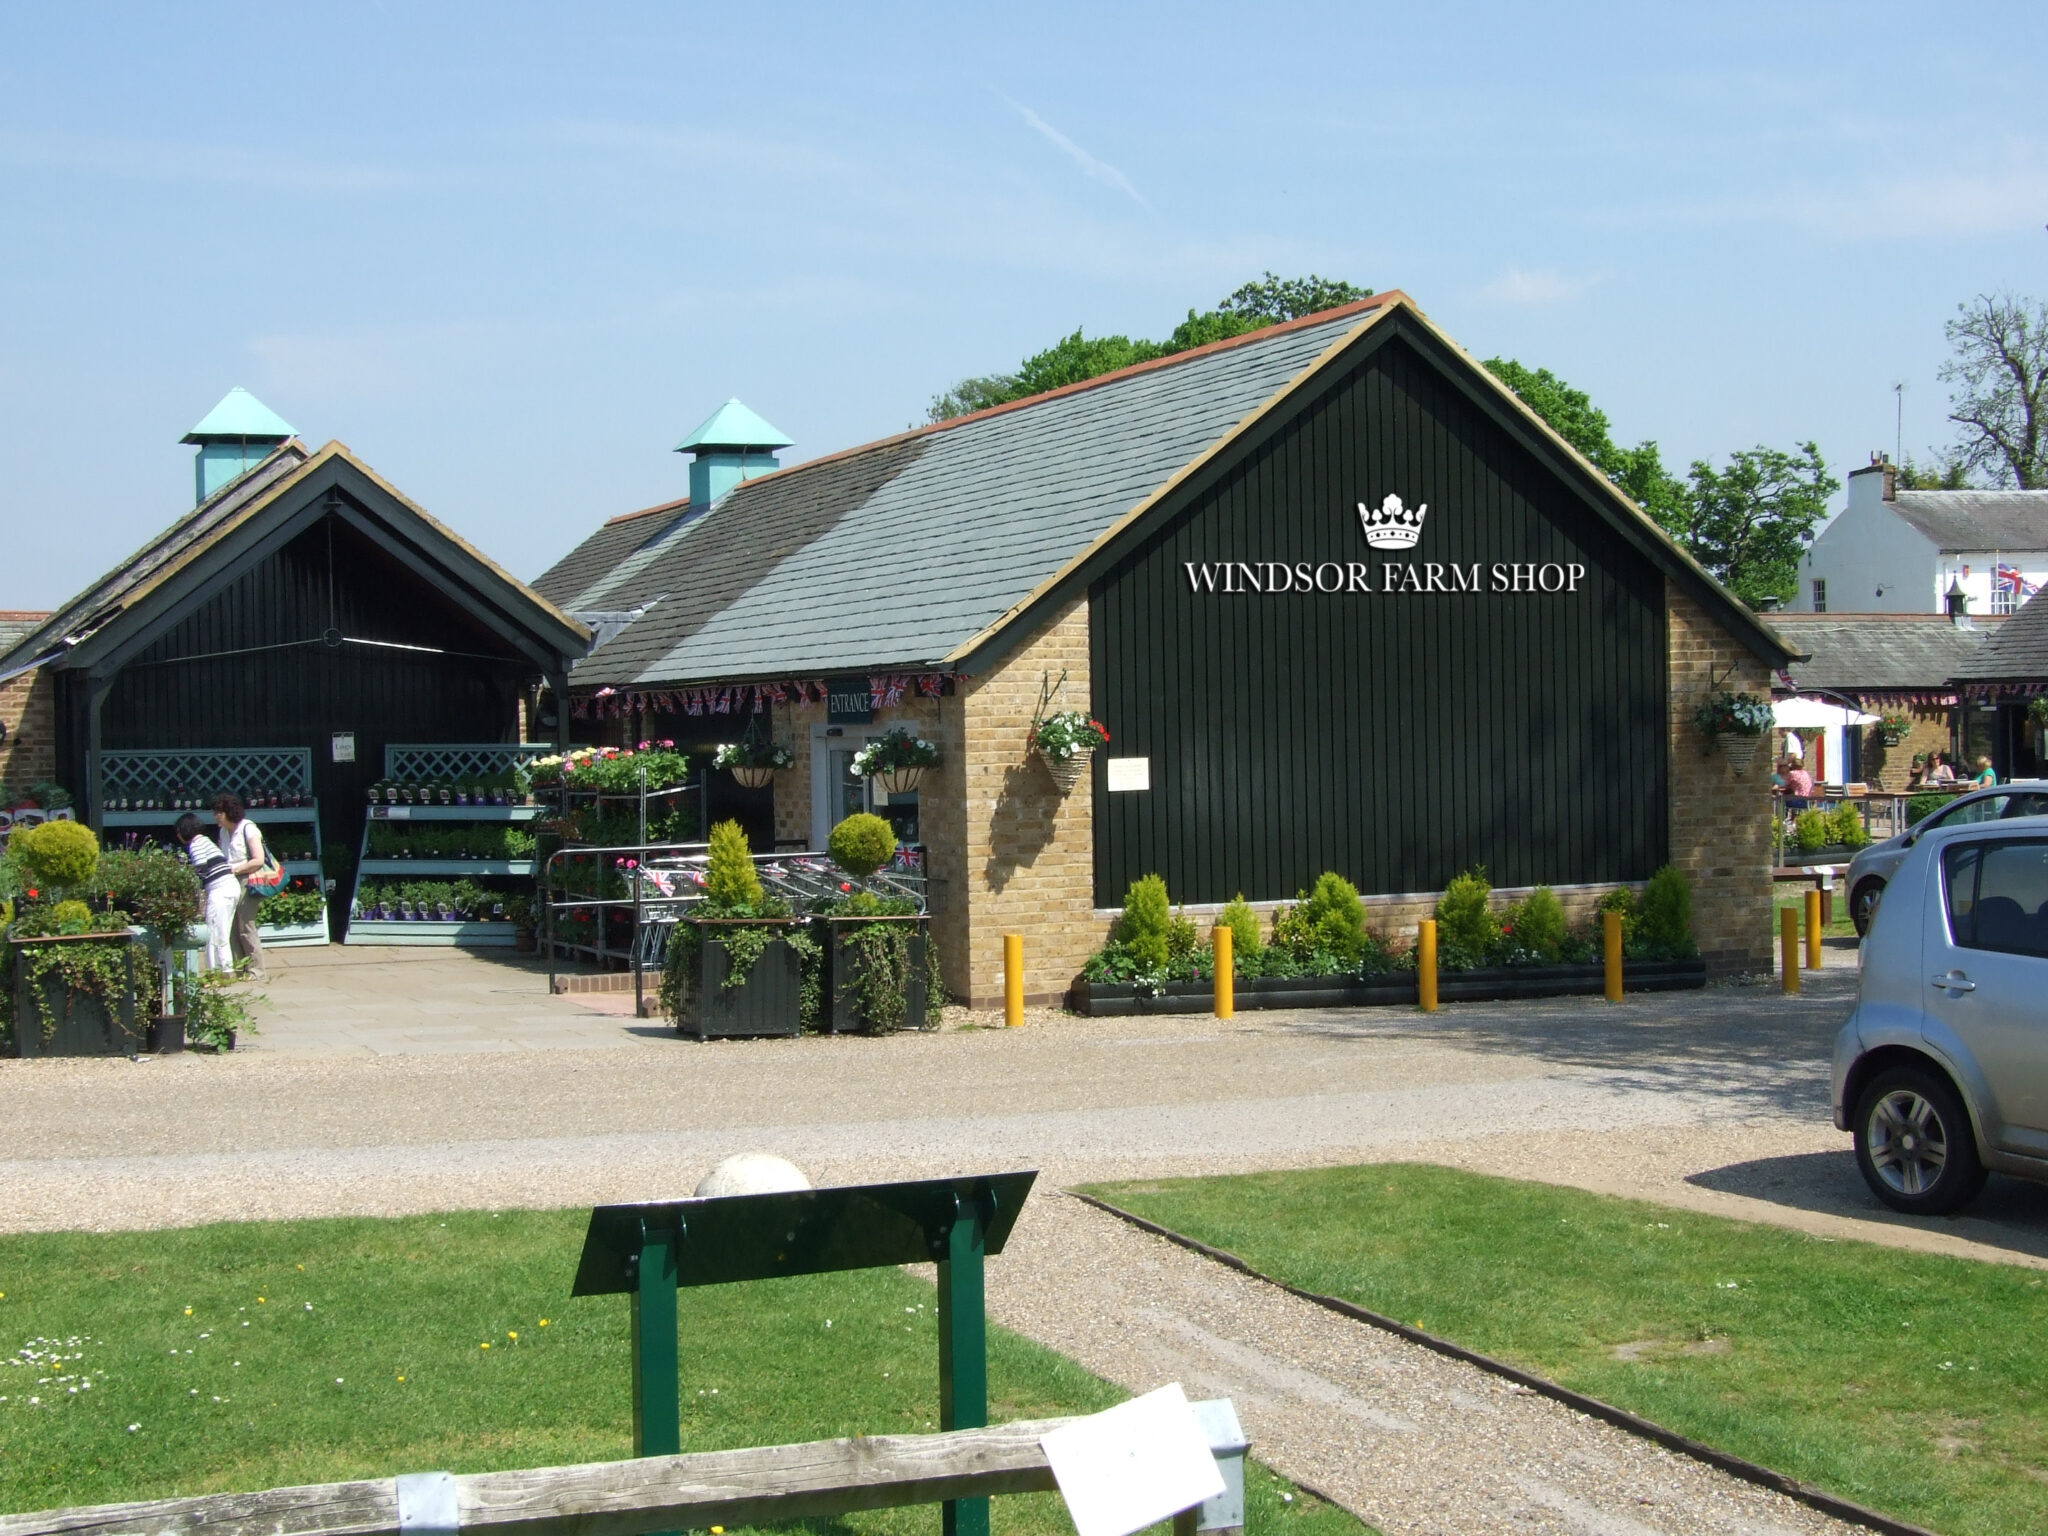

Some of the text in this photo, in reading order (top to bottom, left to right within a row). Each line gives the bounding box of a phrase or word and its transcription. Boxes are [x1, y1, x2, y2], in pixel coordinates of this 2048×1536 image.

[1184, 562, 1585, 592] WINDSOR FARM SHOP
[831, 693, 869, 713] ENTRANCE
